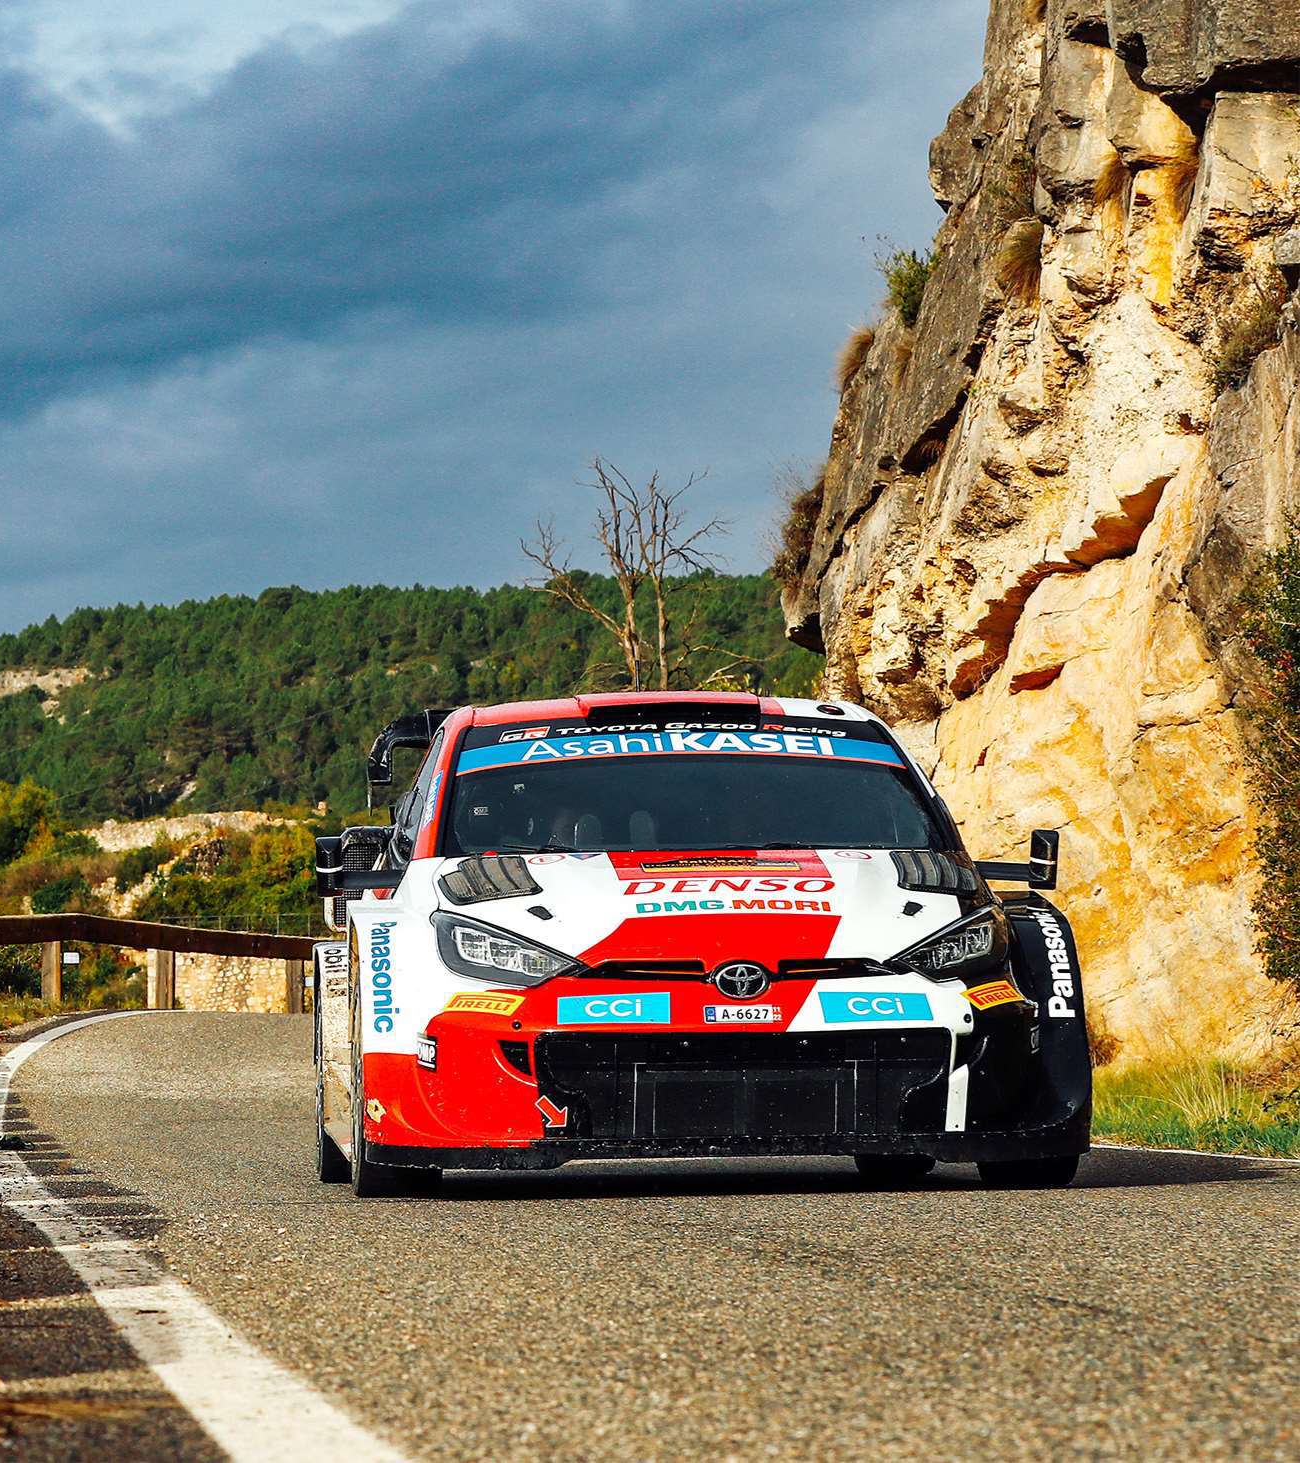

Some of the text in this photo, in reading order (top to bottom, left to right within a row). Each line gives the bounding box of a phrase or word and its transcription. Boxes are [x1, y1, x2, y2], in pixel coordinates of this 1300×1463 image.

[502, 727, 548, 742] GR
[555, 722, 847, 738] TOYOTA GAZOO Racing
[623, 878, 837, 896] DENSO
[636, 899, 832, 914] DMG MORI
[1033, 911, 1076, 1018] Panasonic
[371, 921, 400, 1033] Panasonic
[448, 995, 516, 1011] PIRELLI
[968, 984, 1018, 1006] PIRELLI
[721, 1008, 770, 1020] A-6627
